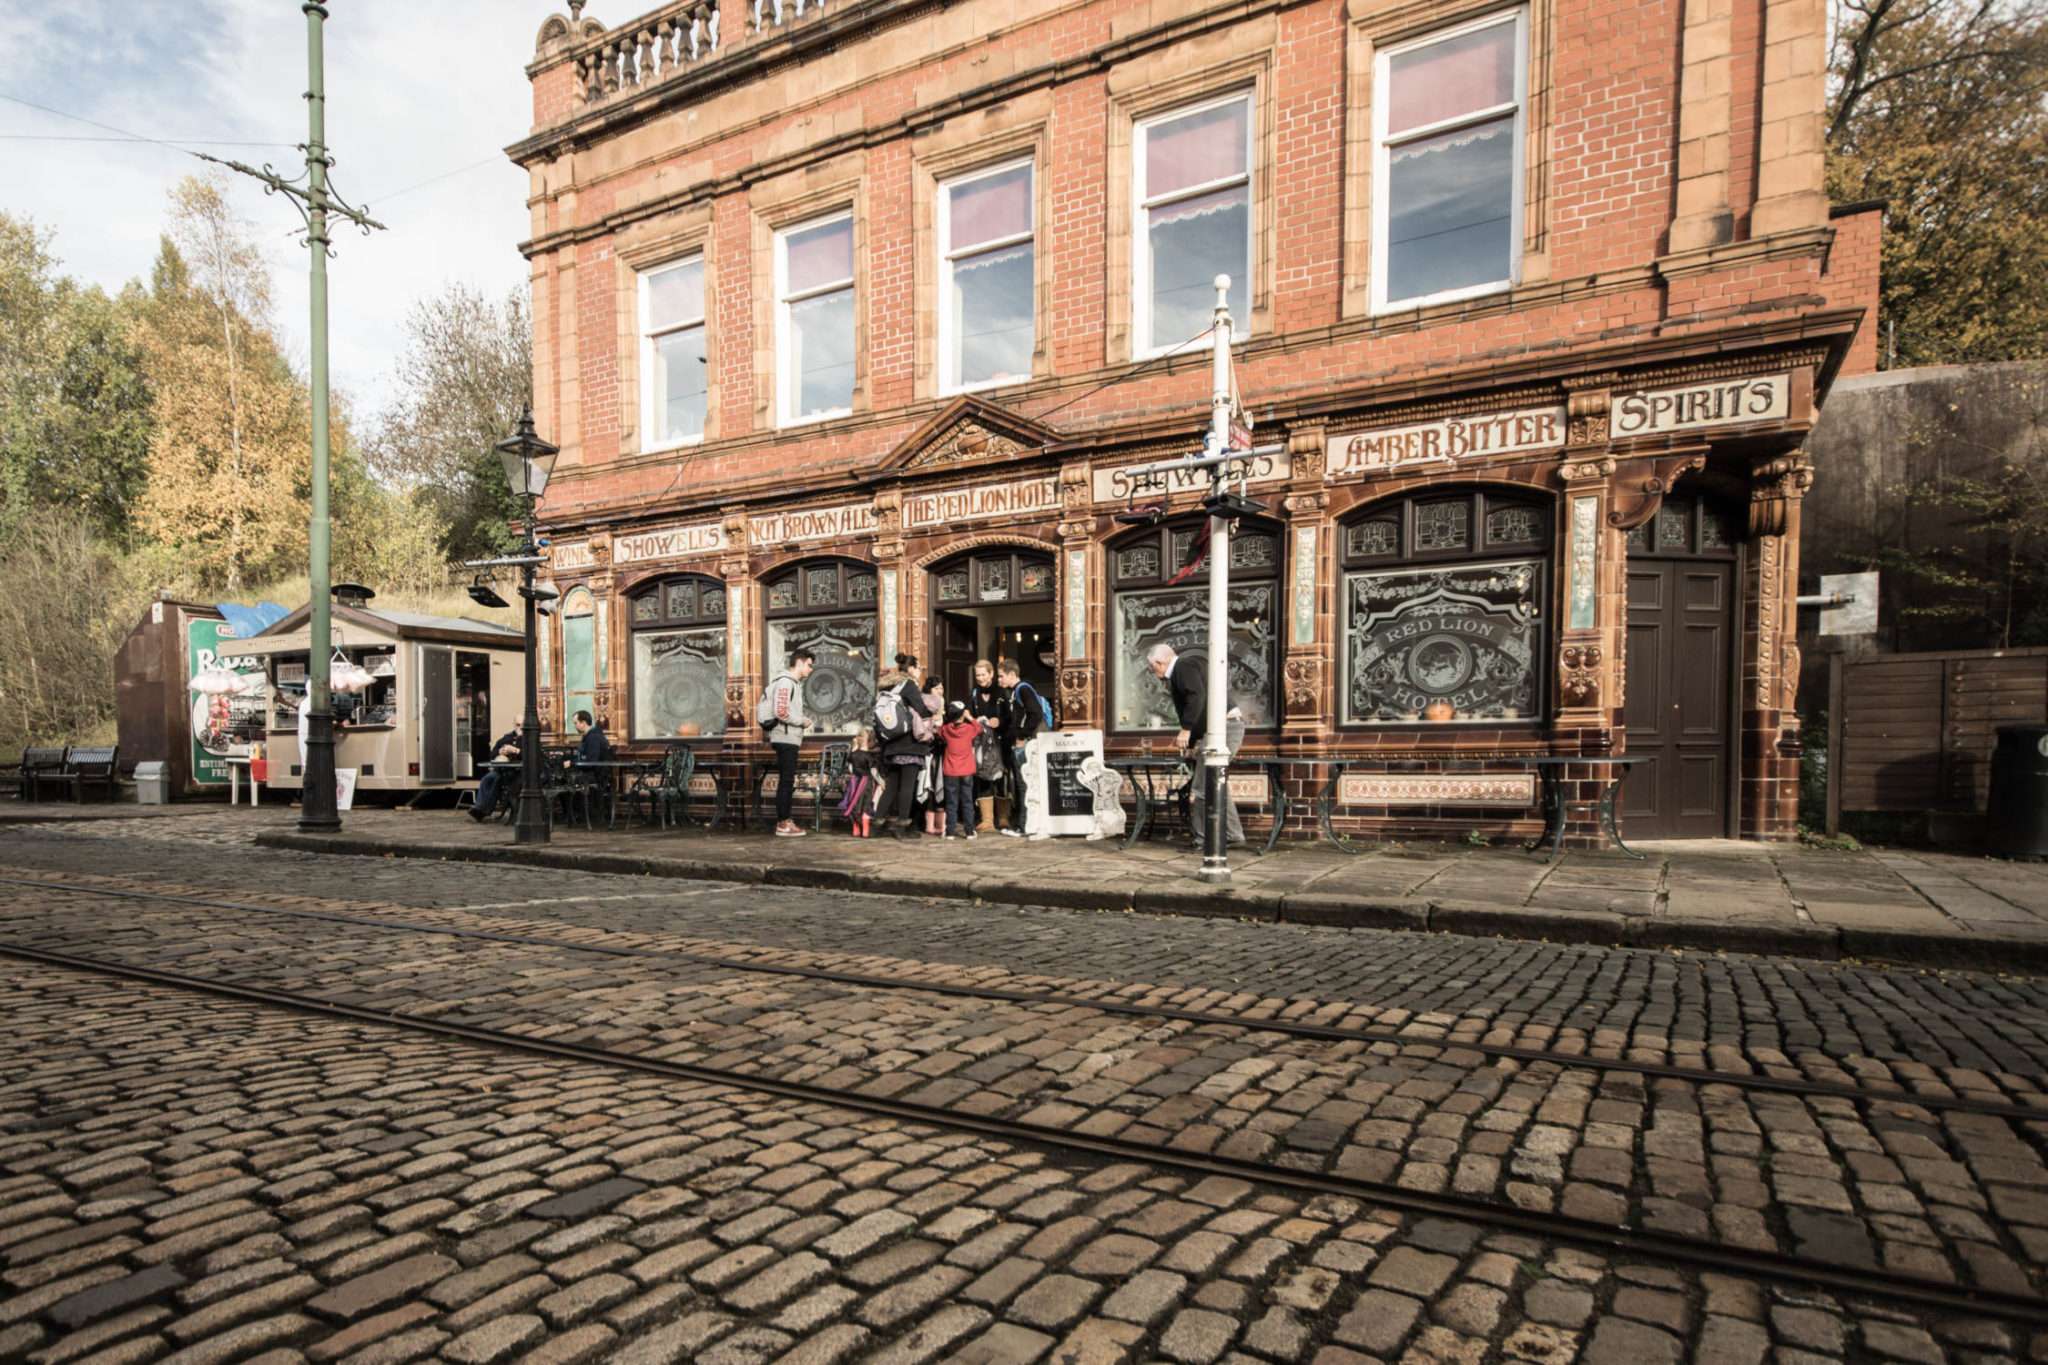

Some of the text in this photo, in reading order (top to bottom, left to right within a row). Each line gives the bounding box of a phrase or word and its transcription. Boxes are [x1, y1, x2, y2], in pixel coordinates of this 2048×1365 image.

[1618, 380, 1776, 433] SPIRITS
[1333, 412, 1558, 474] AMBER BITTER
[903, 479, 1059, 528] THE RED LION HOTEL
[749, 517, 780, 547] NUT
[783, 511, 838, 542] BROWN
[1385, 617, 1494, 643] RED LION
[1391, 686, 1489, 711] HOTEL
